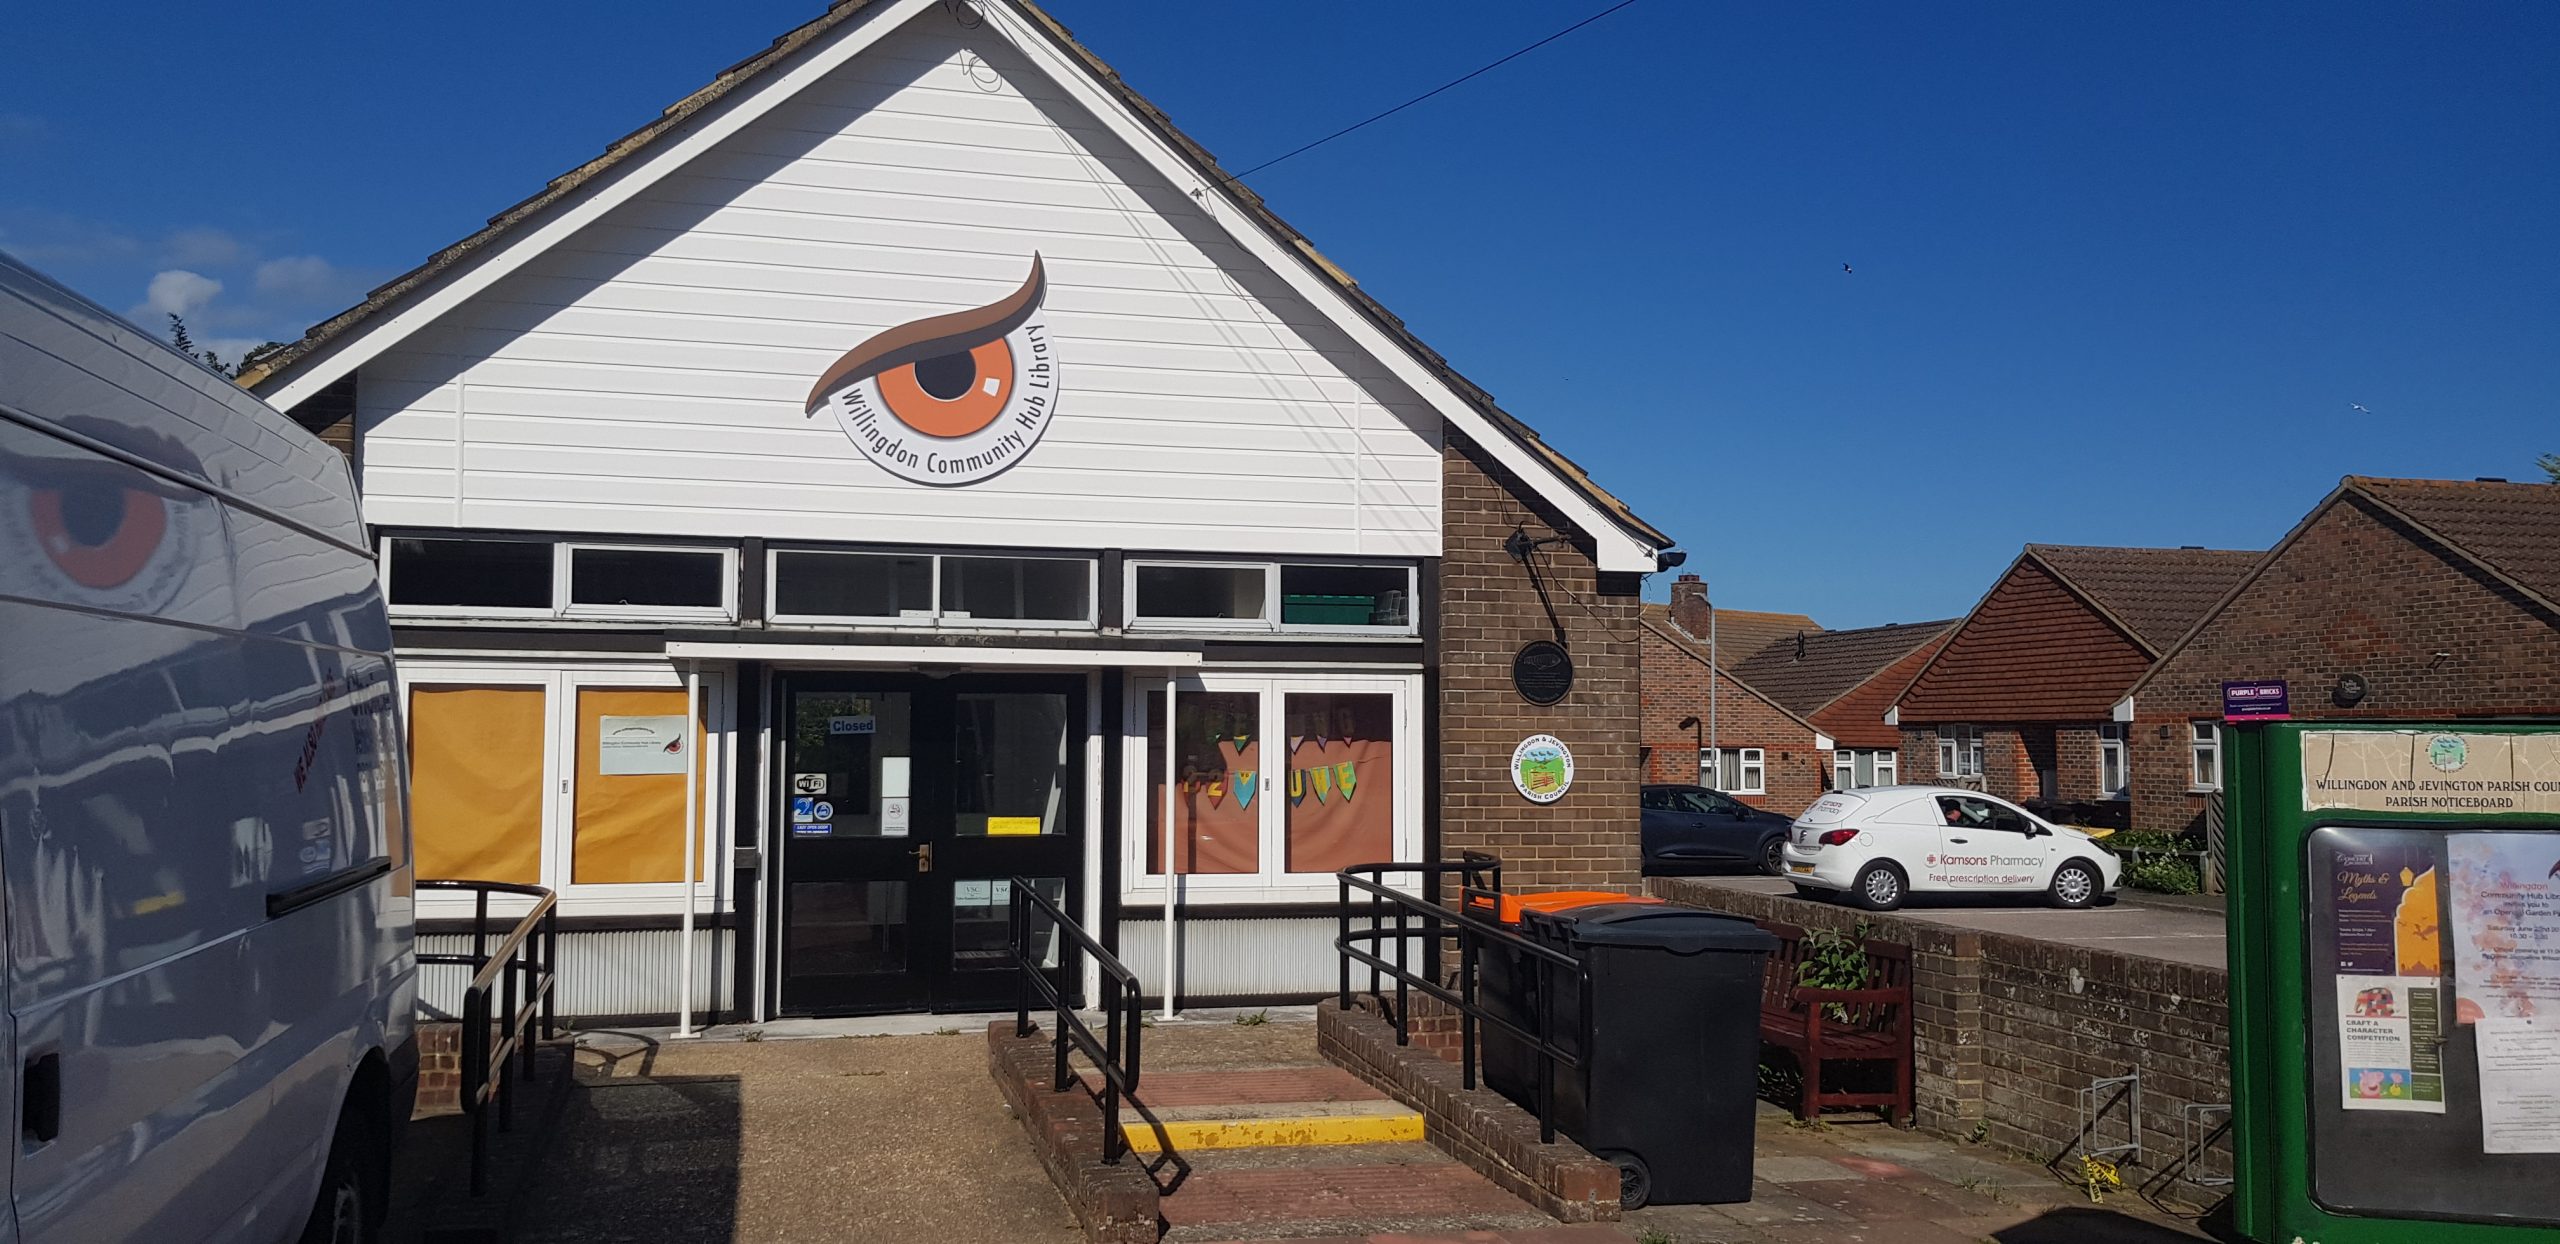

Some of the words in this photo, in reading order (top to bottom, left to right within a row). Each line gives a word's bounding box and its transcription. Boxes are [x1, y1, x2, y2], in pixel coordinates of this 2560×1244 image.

[1025, 324, 1050, 389] Library
[1016, 397, 1046, 430] Hub
[842, 388, 918, 469] Willingdon
[927, 430, 1026, 474] Community
[833, 720, 873, 731] Closed
[2316, 779, 2387, 790] WILLINGDON
[2391, 780, 2416, 791] AND
[2419, 780, 2484, 792] JEVINGTON
[2487, 781, 2530, 792] PARISH
[2534, 781, 2560, 792] COU
[2385, 796, 2428, 807] PARISH
[2431, 797, 2514, 808] NOTICEBOARD
[1940, 854, 1988, 866] Kamsons
[1990, 855, 2045, 868] Pharmacy
[1929, 873, 1948, 882] Free
[1950, 874, 1997, 884] prescription
[2001, 874, 2035, 883] delivery
[2337, 871, 2376, 887] Myths
[2337, 886, 2377, 903] Legends
[2346, 1034, 2401, 1042] COMPETITION
